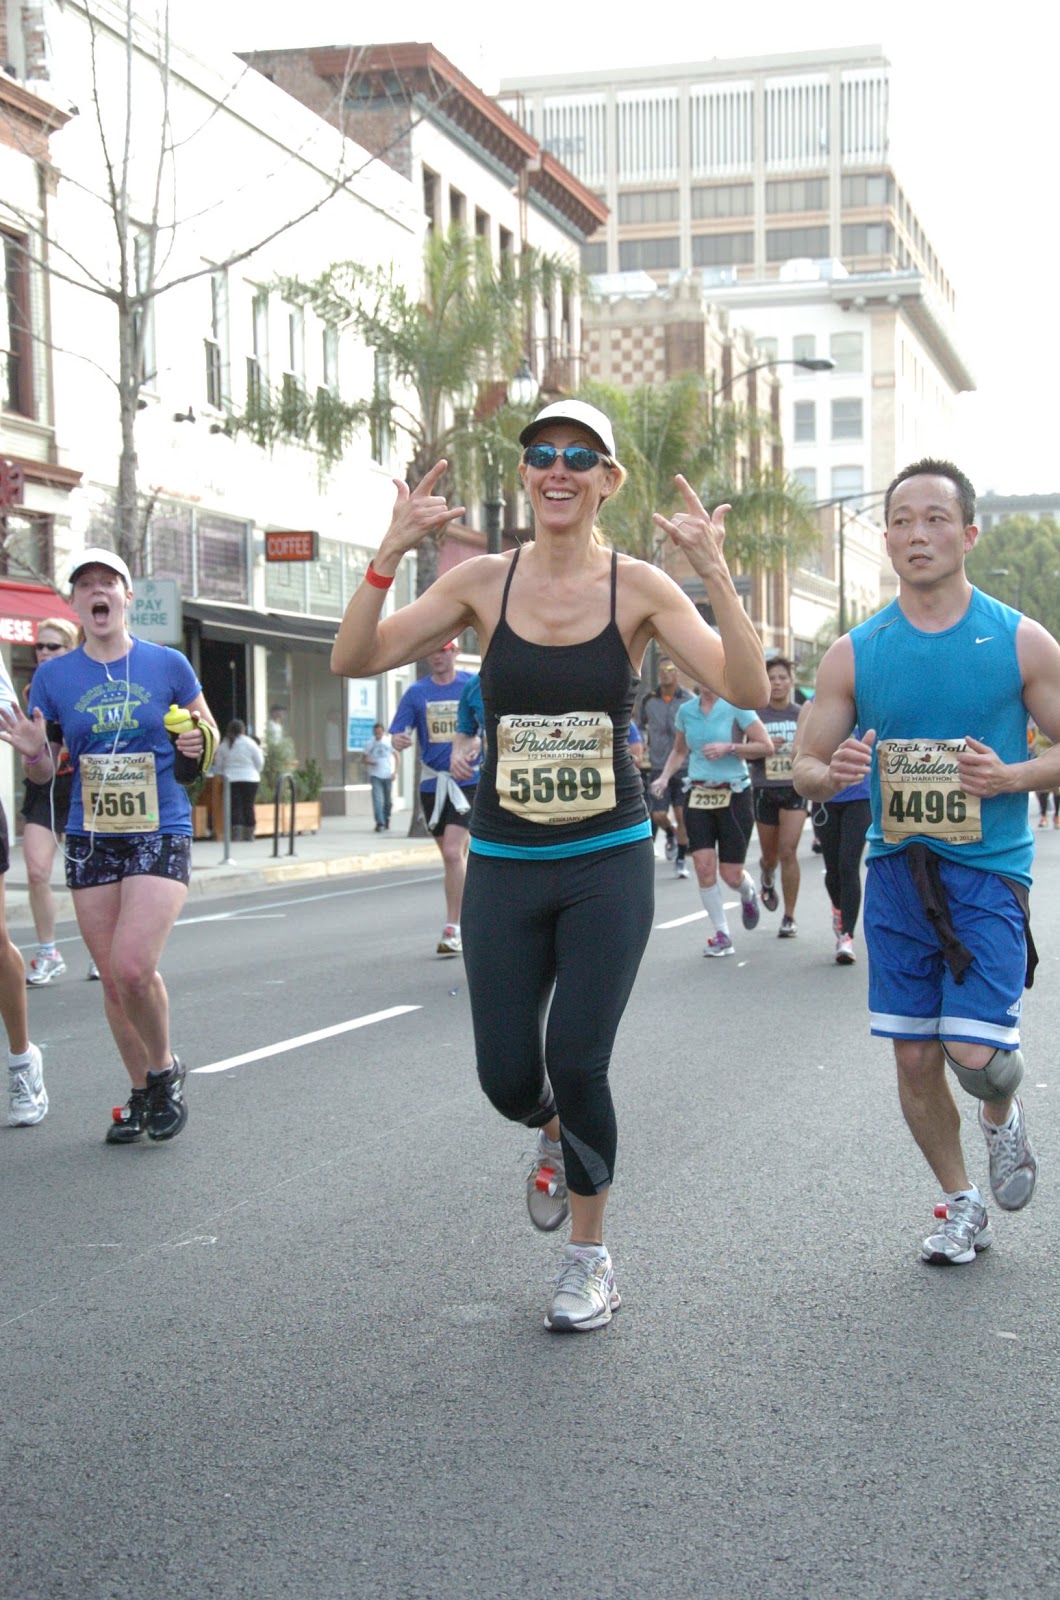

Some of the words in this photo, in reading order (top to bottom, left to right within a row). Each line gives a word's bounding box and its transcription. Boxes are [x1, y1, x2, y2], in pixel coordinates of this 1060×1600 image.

[268, 537, 310, 555] COFFEE
[135, 599, 162, 610] PAY
[131, 613, 167, 625] HERE
[510, 718, 551, 728] Rock
[566, 717, 600, 727] Roll
[512, 730, 597, 753] Pasadena
[886, 743, 921, 753] Rock
[936, 743, 967, 753] Roll
[88, 766, 145, 781] Pasadena
[509, 767, 602, 804] 5589
[91, 792, 147, 817] 5561
[695, 794, 727, 806] 2352
[889, 790, 967, 824] 4496
